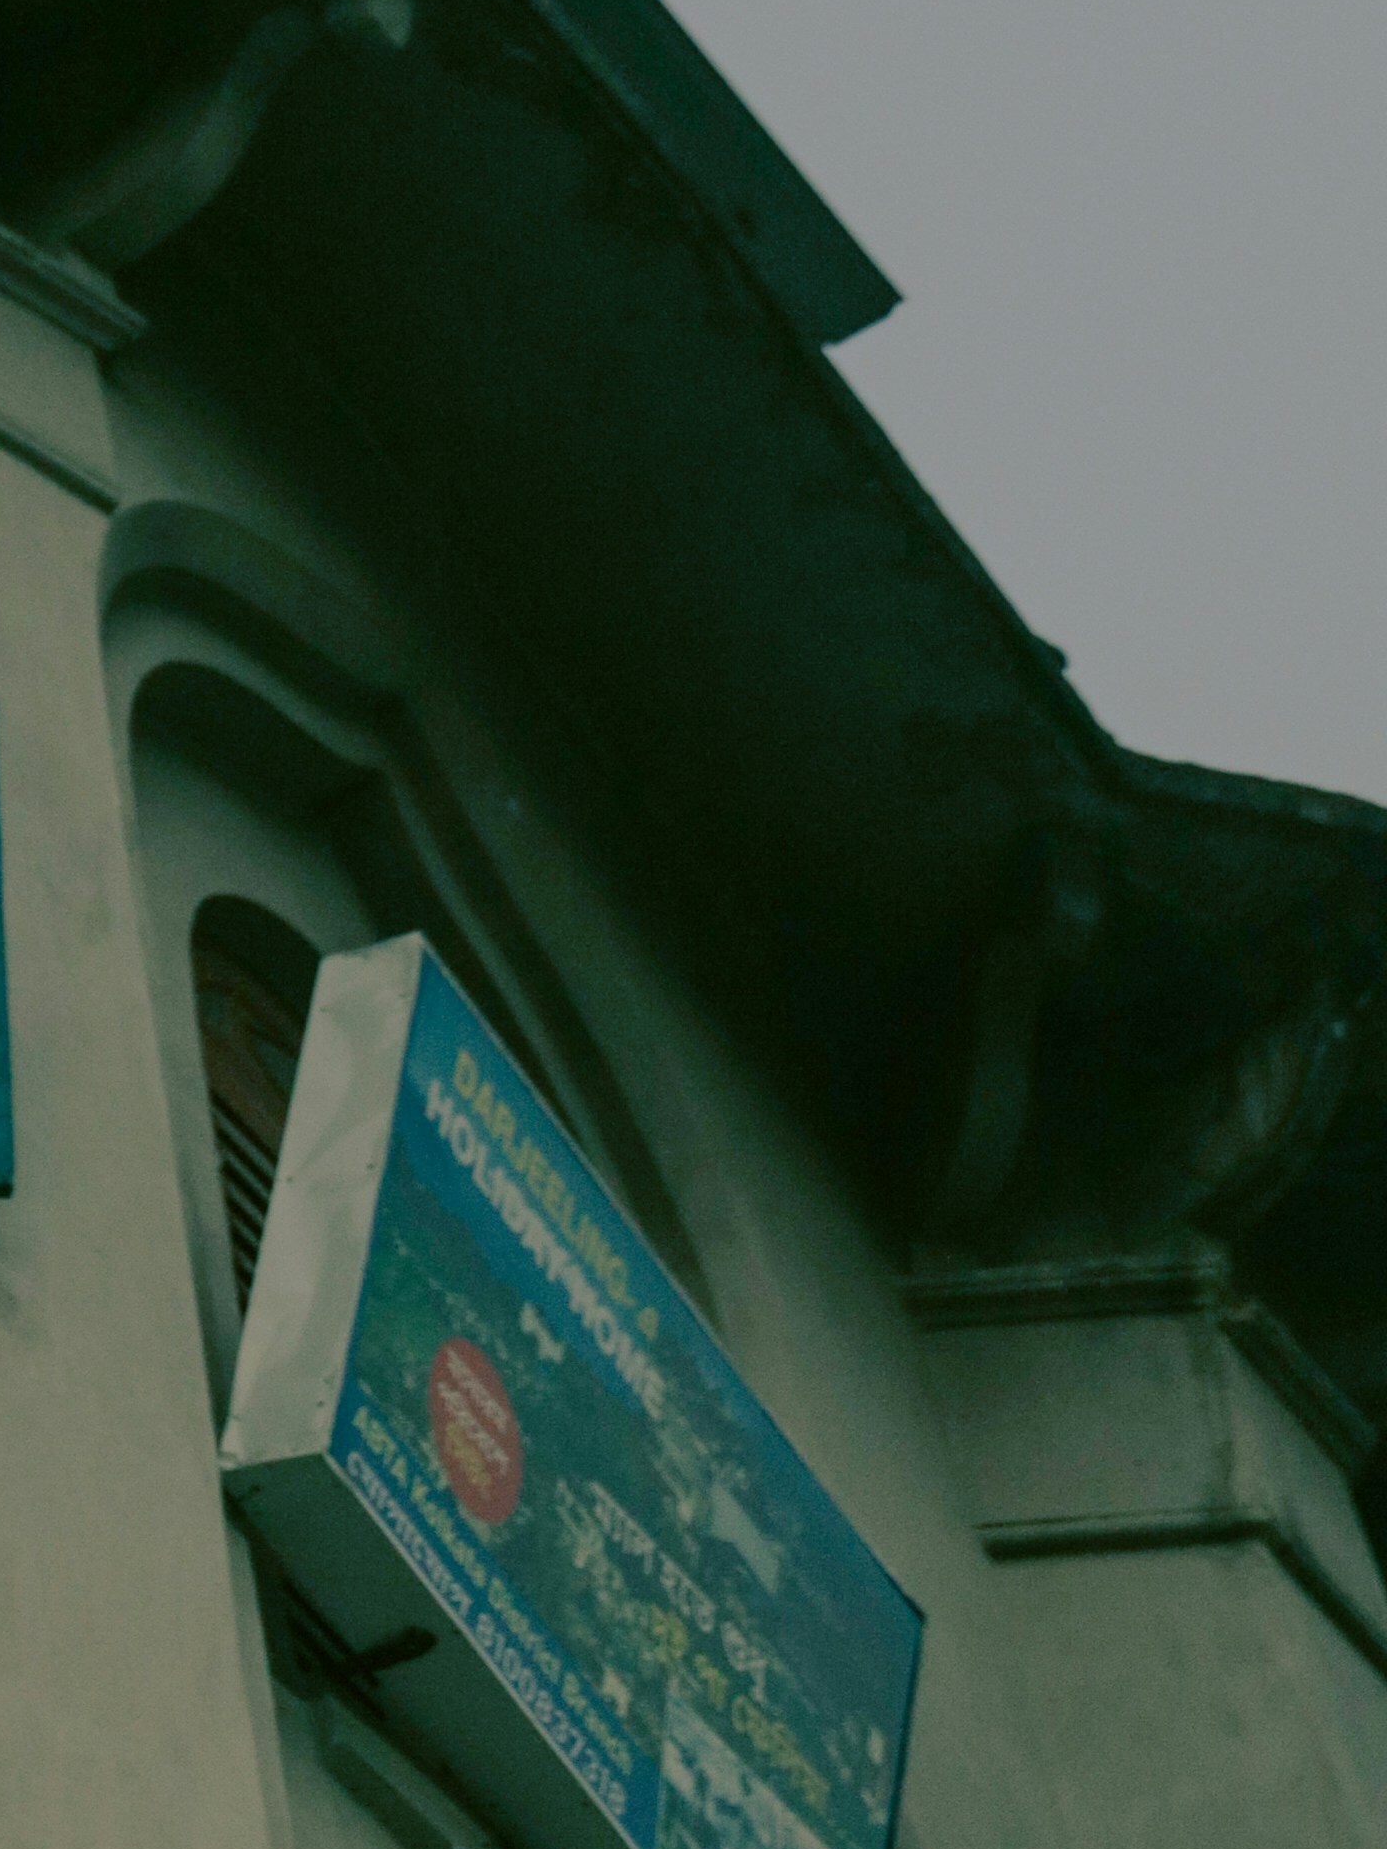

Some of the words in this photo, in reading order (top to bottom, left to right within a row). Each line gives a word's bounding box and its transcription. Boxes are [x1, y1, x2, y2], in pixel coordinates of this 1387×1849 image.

[411, 1474, 487, 1588] Kolkata
[487, 1577, 562, 1683] District
[562, 1672, 633, 1776] Branch
